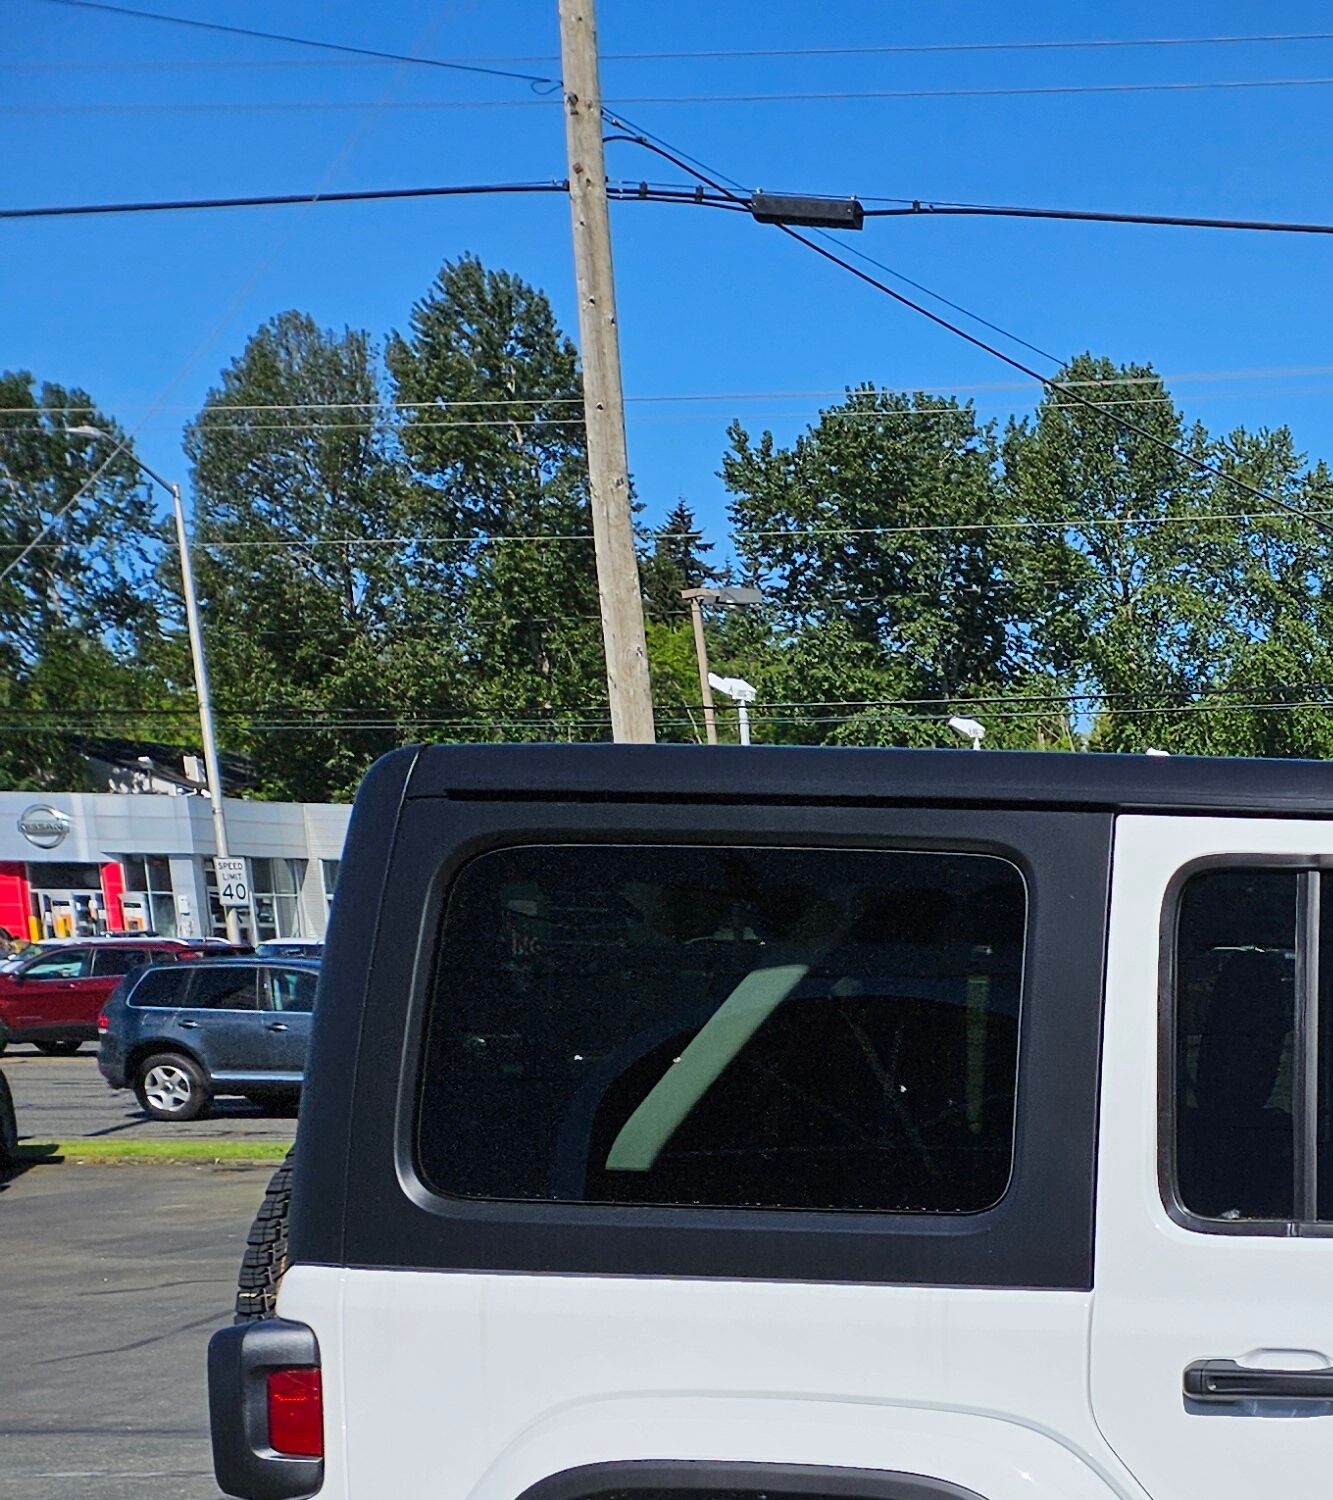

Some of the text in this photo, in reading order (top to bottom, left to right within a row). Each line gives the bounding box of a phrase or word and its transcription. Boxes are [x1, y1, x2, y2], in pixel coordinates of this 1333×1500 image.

[21, 823, 64, 833] NISSAN
[218, 862, 243, 870] SPEED
[222, 873, 242, 881] LIMIT
[222, 883, 246, 900] 40
